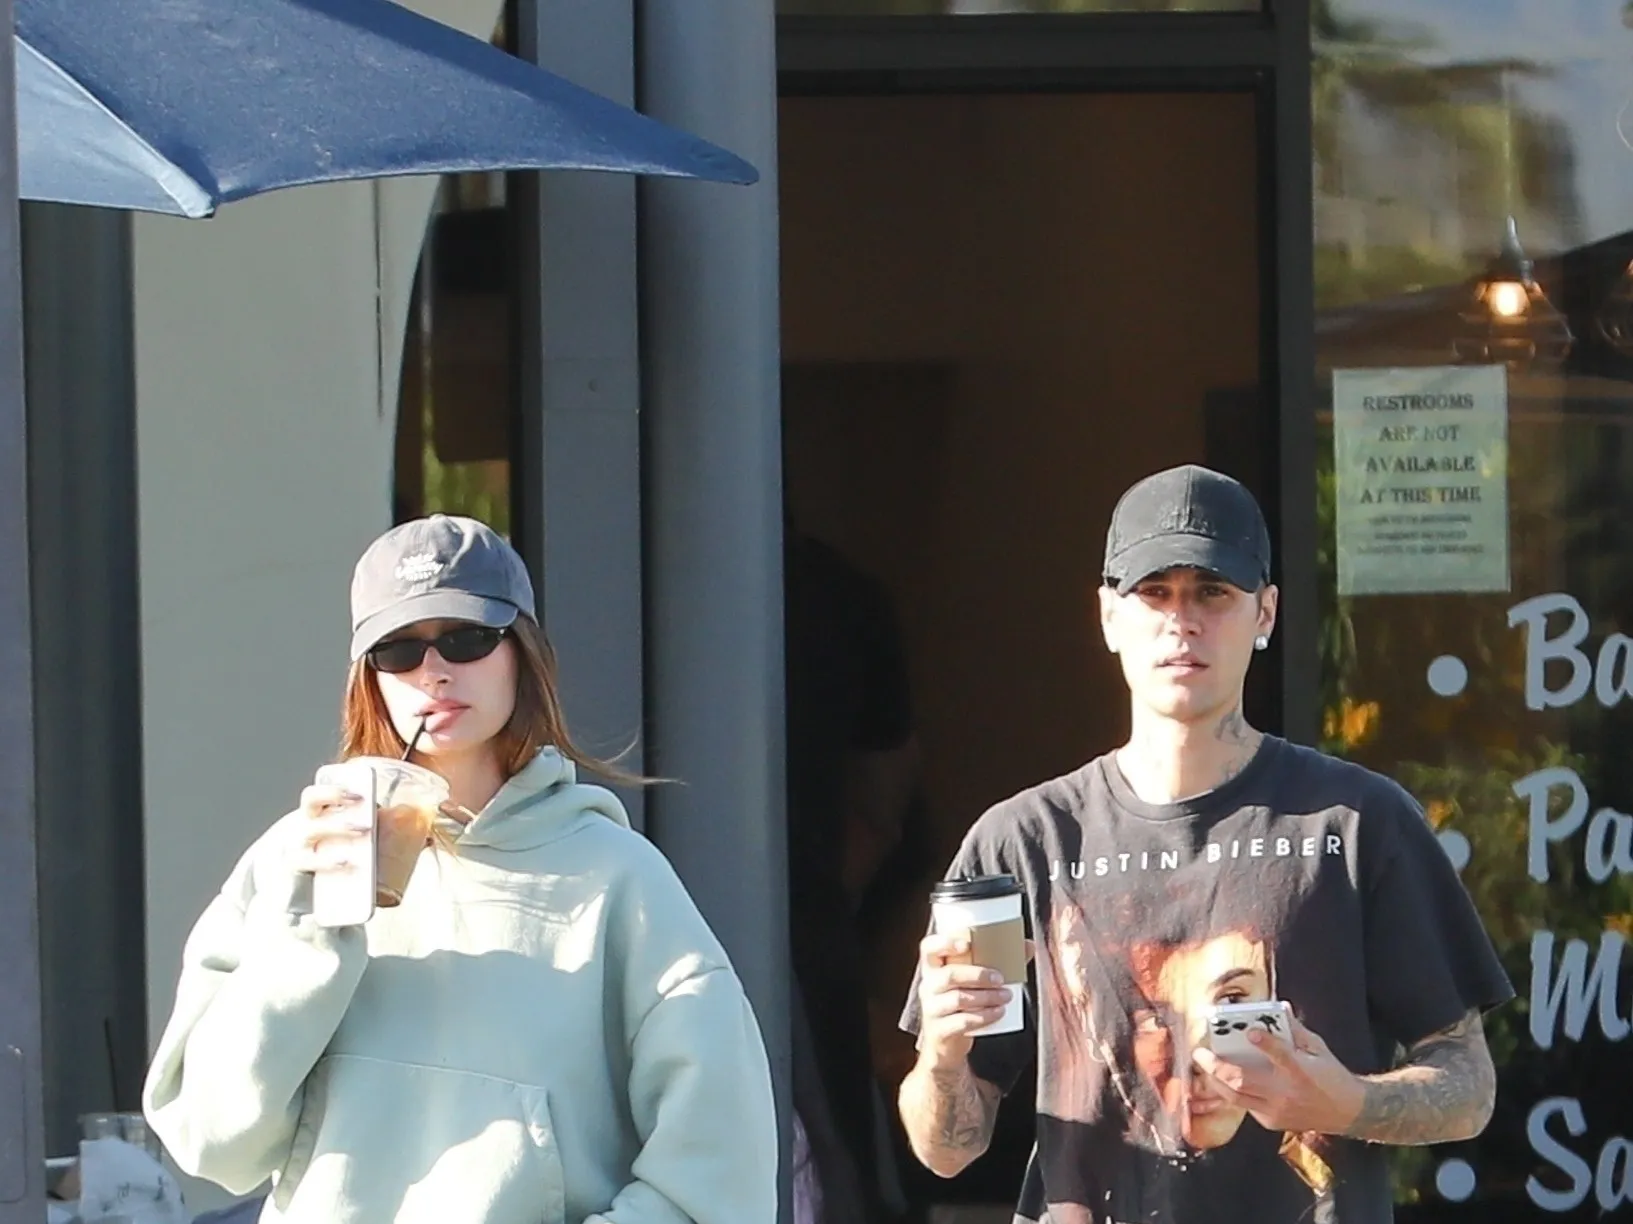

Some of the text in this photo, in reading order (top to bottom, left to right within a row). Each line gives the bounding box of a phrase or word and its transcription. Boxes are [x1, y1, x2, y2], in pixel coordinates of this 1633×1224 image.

[1362, 392, 1474, 412] RESTROOMS
[1378, 424, 1461, 443] ARE NOT
[1365, 456, 1476, 473] AVAILABLE
[1359, 486, 1482, 504] AT THIS TIME
[1050, 834, 1342, 882] JUSTIN BIEBER
[1529, 929, 1633, 1049] M
